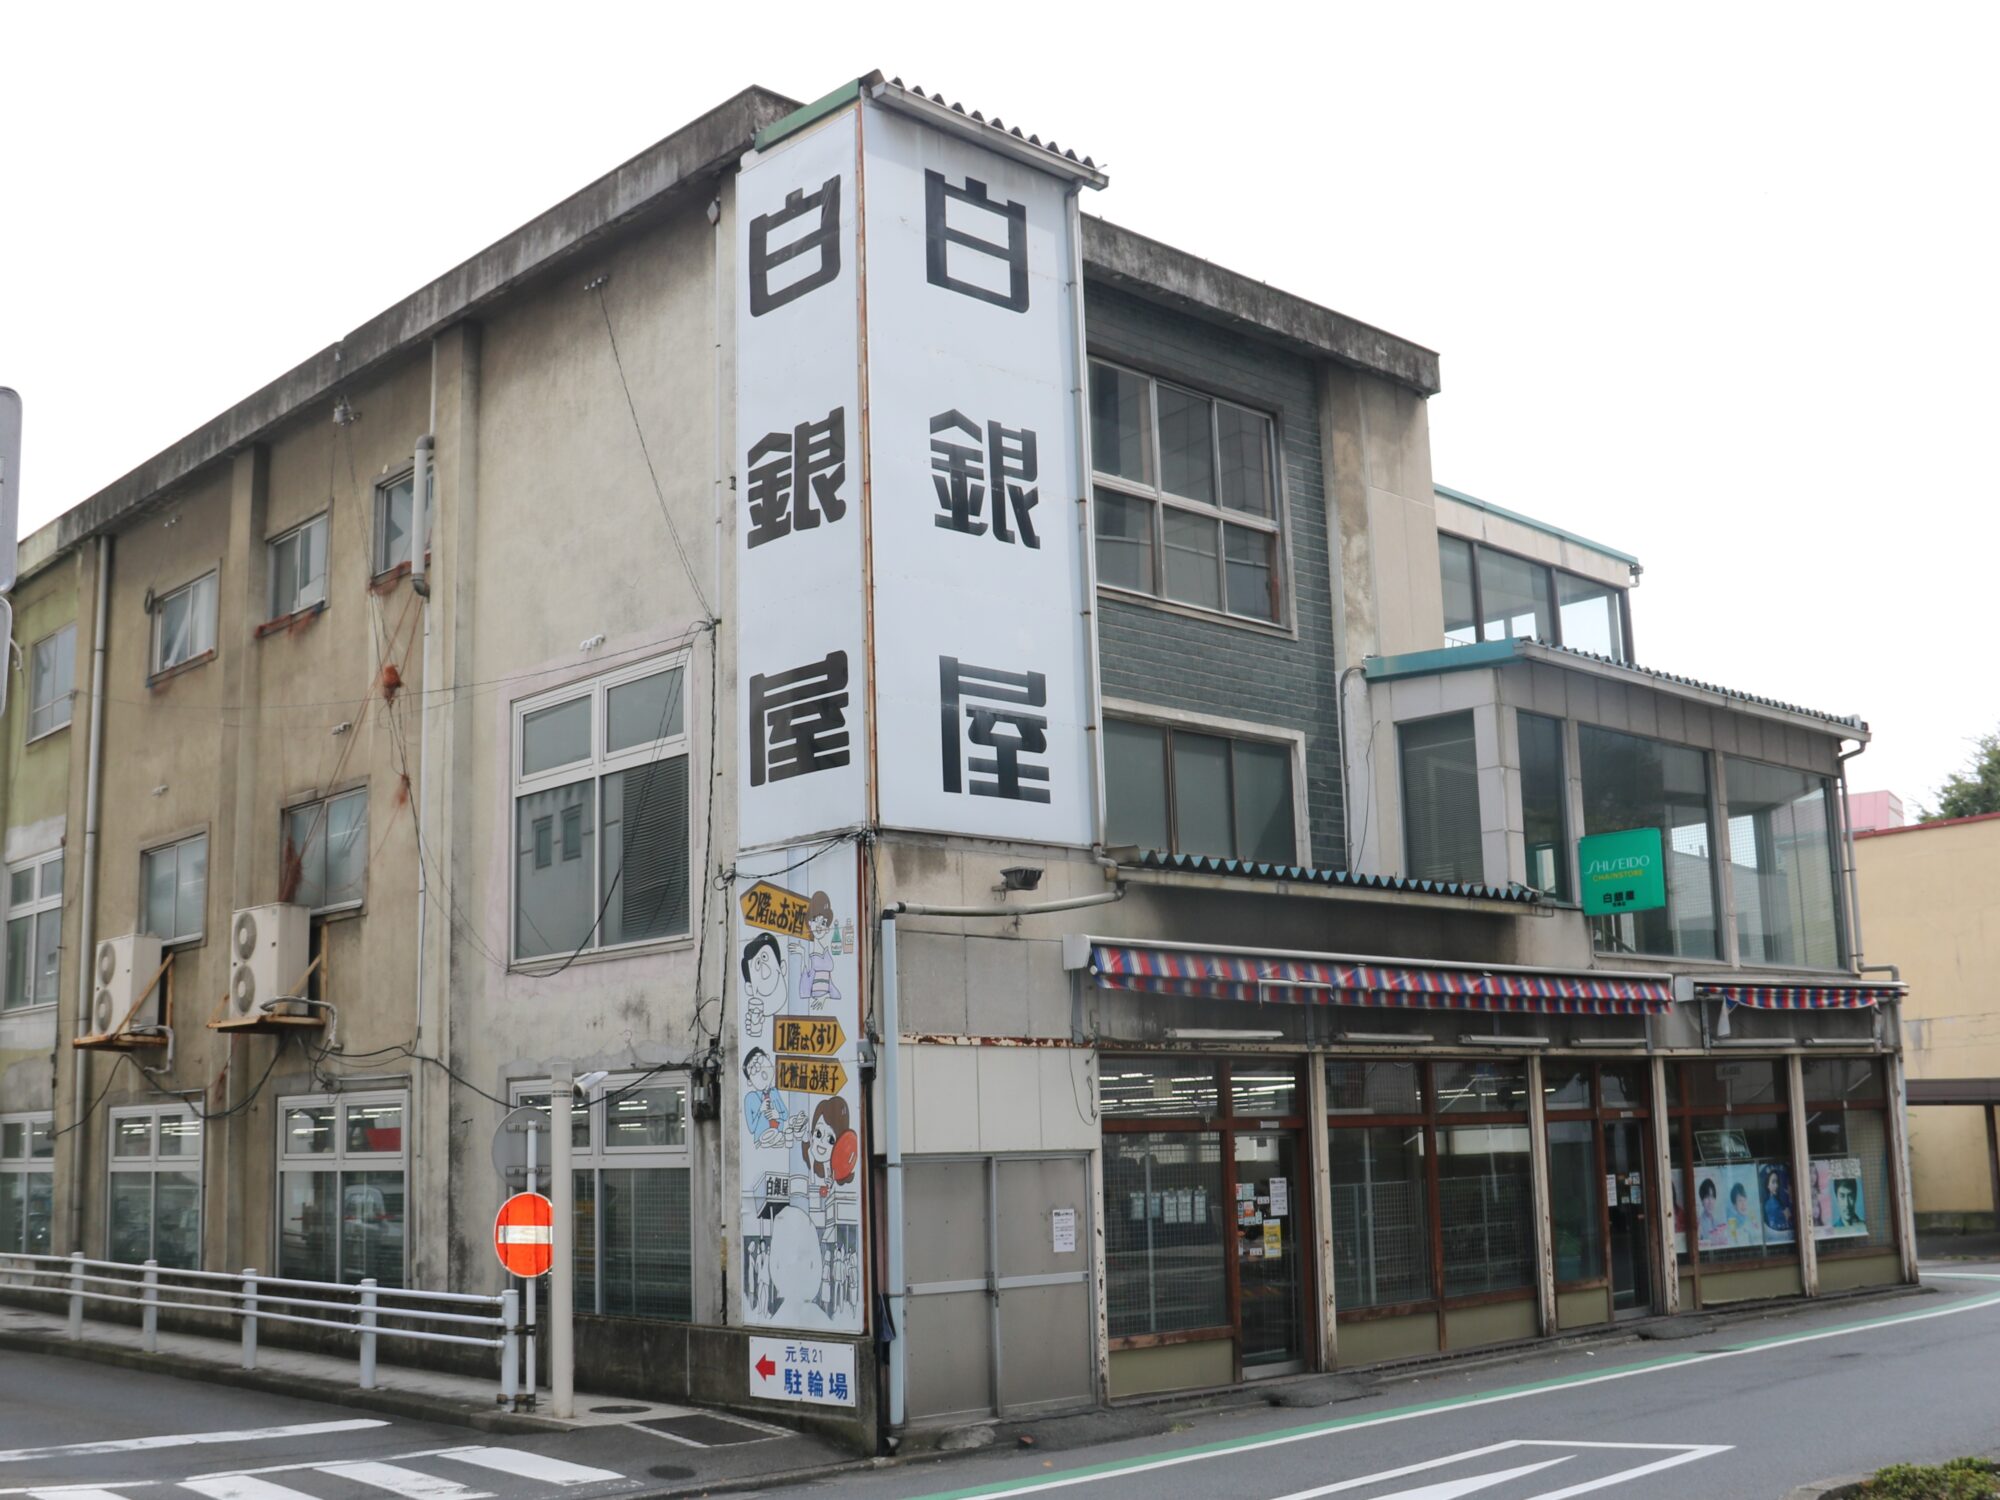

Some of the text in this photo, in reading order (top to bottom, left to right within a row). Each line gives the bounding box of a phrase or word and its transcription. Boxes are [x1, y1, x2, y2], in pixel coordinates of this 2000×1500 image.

[747, 172, 851, 788] 白銀屋
[924, 167, 1052, 805] 白銀屋
[1584, 855, 1650, 874] SHISEIDO
[745, 890, 807, 936] 2階はお酒
[778, 1022, 838, 1052] 1階はくすり
[765, 1175, 789, 1196] 白銀屋
[785, 1346, 823, 1363] 元気21
[784, 1368, 848, 1401] 駐輪場
